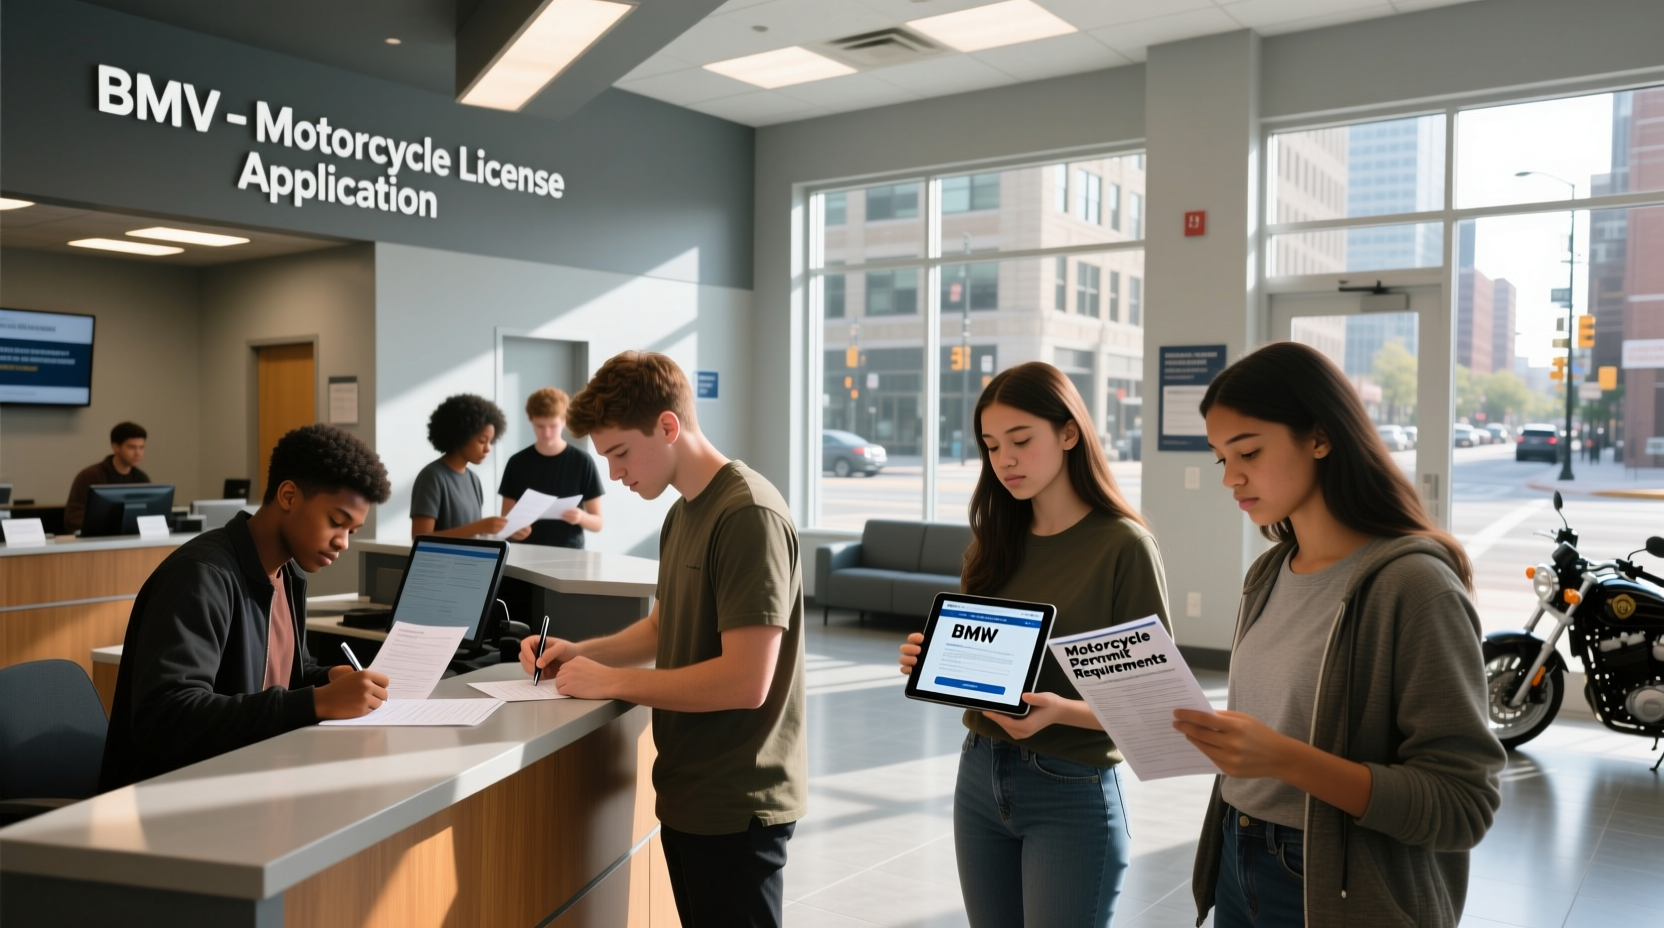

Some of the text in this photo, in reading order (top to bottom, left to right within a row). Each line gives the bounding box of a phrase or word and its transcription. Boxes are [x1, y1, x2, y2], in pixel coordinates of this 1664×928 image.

[98, 64, 221, 133] BMV
[256, 100, 452, 185] Motorcycle
[459, 145, 565, 199] License
[237, 151, 438, 219] Application
[951, 623, 999, 644] BMW
[1064, 631, 1151, 657] Motorcycle
[1073, 654, 1168, 680] Requirements
